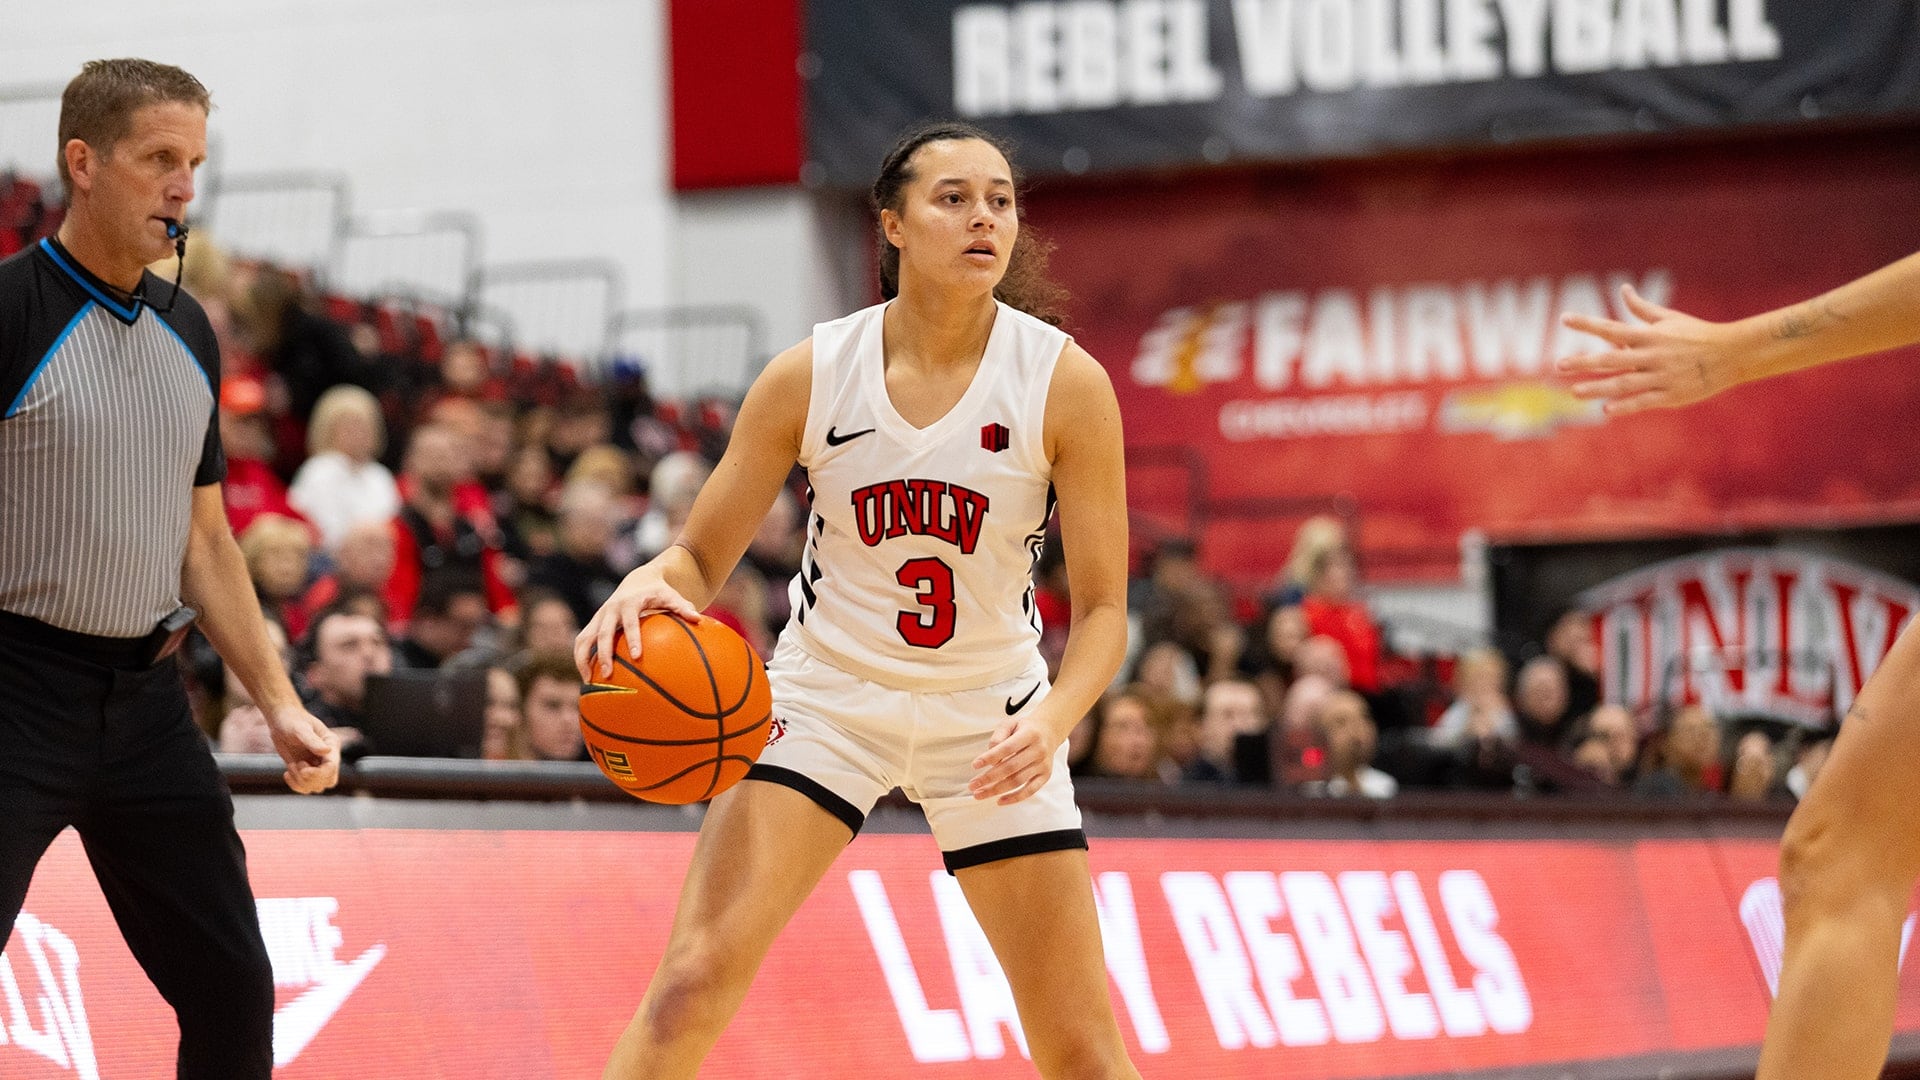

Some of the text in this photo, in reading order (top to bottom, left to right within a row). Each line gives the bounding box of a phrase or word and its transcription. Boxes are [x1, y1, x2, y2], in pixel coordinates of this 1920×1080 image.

[953, 0, 1779, 115] REBEL VOLLEYBALL
[851, 479, 989, 554] UNLV
[896, 556, 956, 649] 3
[848, 870, 1171, 1062] LAY
[1160, 869, 1533, 1049] REBELS
